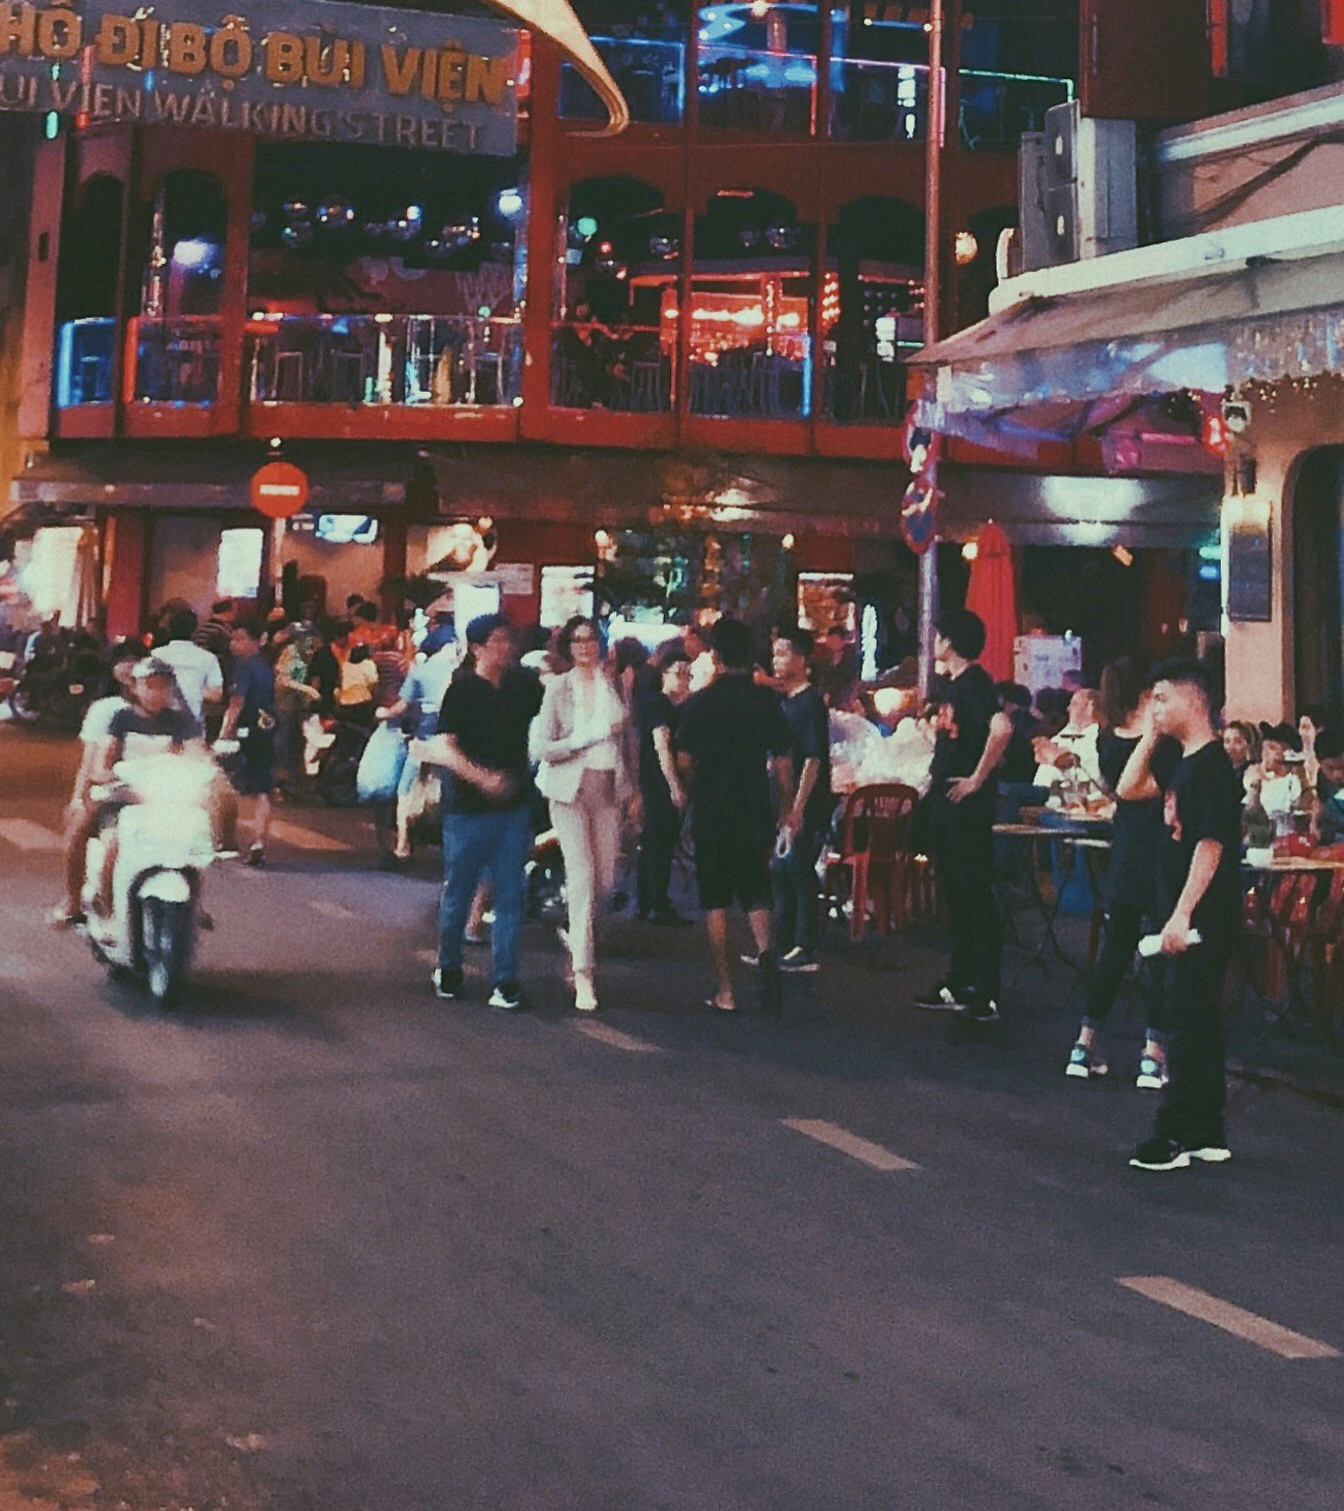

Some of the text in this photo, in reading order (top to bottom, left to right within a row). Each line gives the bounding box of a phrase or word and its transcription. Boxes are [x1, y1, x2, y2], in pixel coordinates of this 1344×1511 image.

[168, 13, 252, 90] BỘ
[380, 39, 509, 112] VIỆN
[52, 78, 141, 117] VIEN
[155, 88, 332, 138] WALKING
[345, 108, 485, 150] STREET
